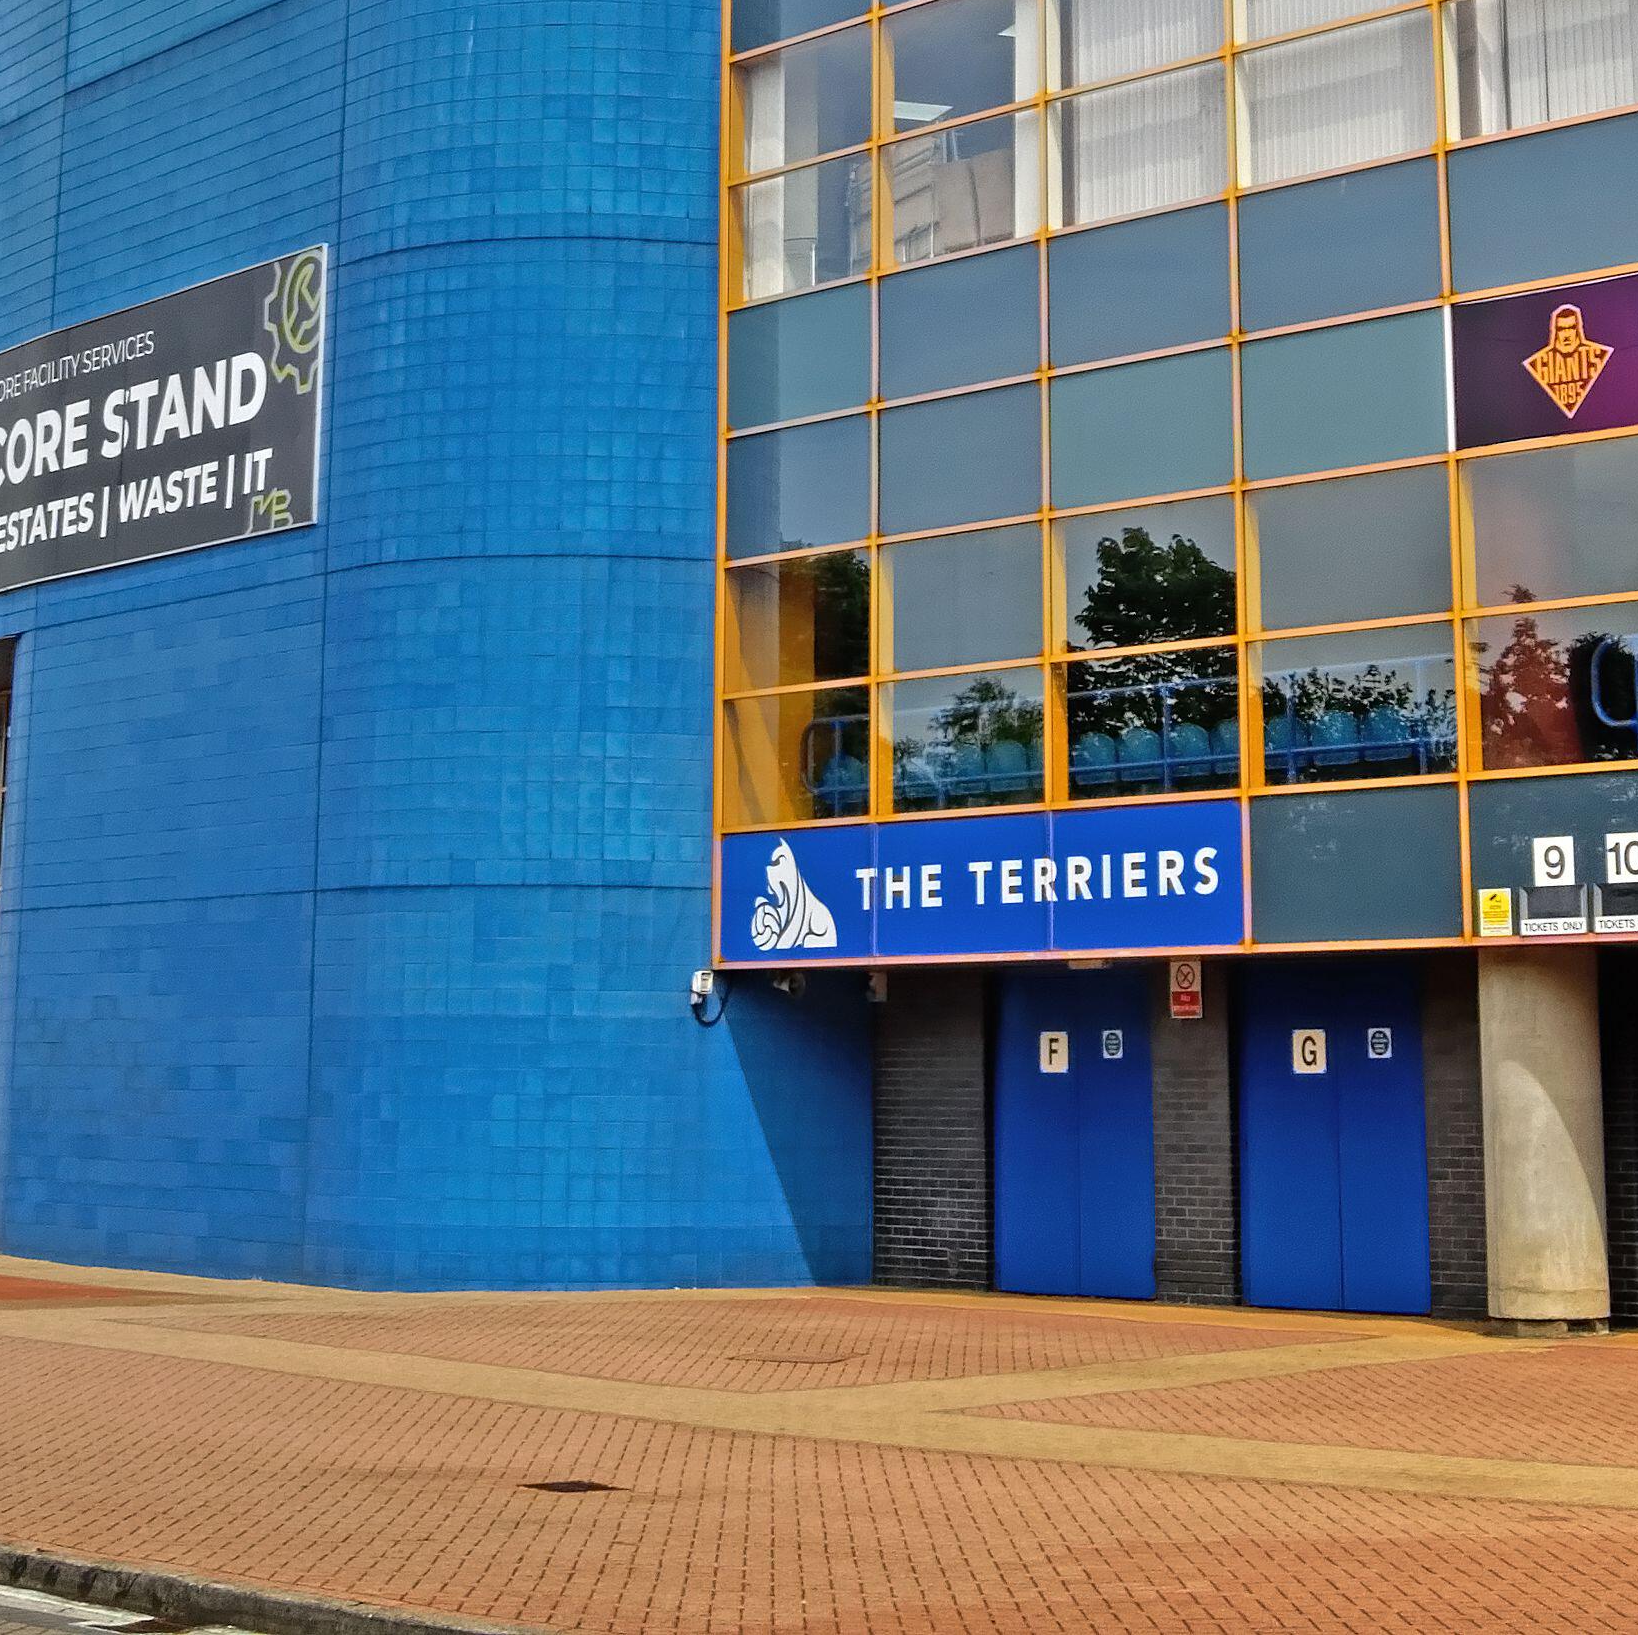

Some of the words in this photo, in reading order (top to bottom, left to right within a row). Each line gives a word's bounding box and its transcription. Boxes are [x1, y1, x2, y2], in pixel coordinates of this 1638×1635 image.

[24, 353, 82, 393] FACILITY
[82, 330, 155, 374] SERVICES
[1536, 346, 1602, 385] GIANTS
[101, 351, 268, 459] STAND
[1553, 381, 1585, 404] 1895
[118, 461, 219, 524] WASTE
[243, 448, 273, 494] IT
[856, 865, 944, 911] THE
[968, 847, 1220, 906] TERRIERS
[1544, 844, 1566, 880] 9
[1523, 922, 1559, 932] TICKETS
[1563, 921, 1584, 931] ONLY
[1598, 919, 1635, 930] TICKETS
[1049, 1037, 1060, 1065] F
[1301, 1035, 1317, 1066] G
